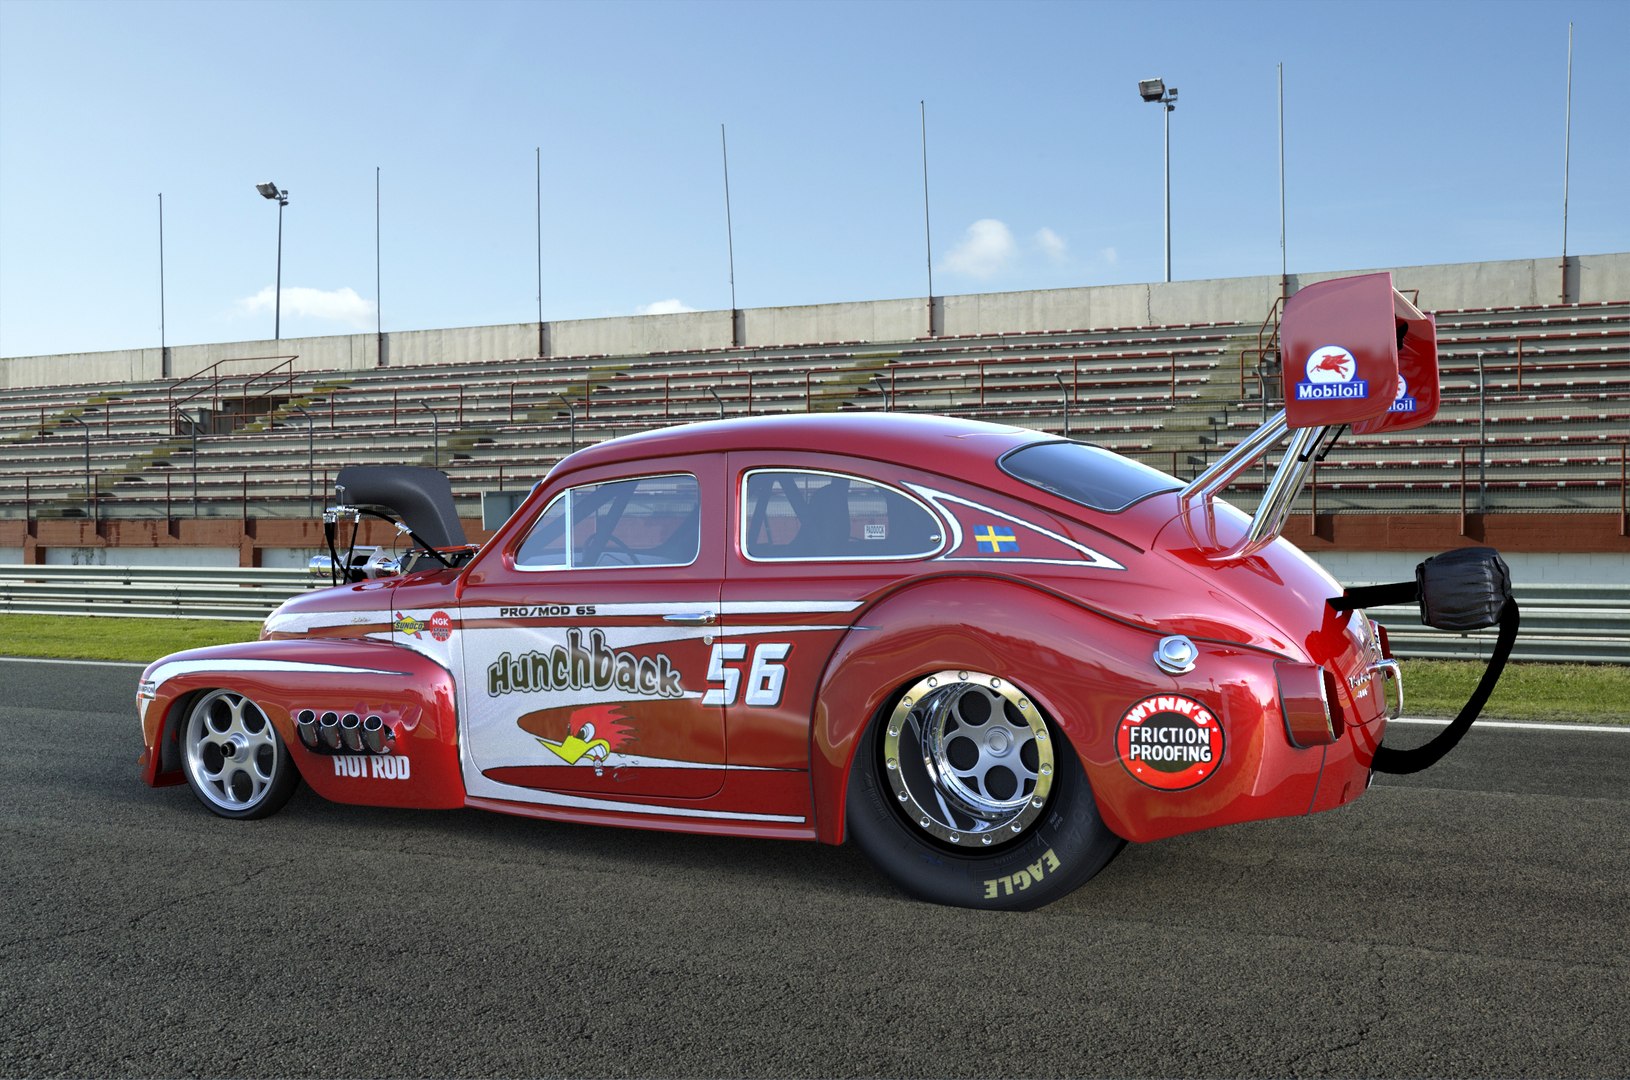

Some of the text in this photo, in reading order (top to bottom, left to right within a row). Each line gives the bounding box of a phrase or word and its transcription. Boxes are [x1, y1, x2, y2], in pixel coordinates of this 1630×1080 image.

[1299, 383, 1364, 398] Mobiloil
[1389, 400, 1412, 410] loil
[500, 606, 596, 617] PRO/MOD 65
[394, 621, 424, 630] SUNOCO
[432, 618, 449, 626] NGK
[488, 628, 684, 697] Hunchback
[702, 643, 793, 706] 56
[1126, 697, 1212, 725] WYNN'S
[1130, 726, 1210, 744] FRICTION
[1130, 744, 1212, 762] PROOFING
[332, 755, 411, 780] HOT ROD
[983, 848, 1061, 899] EAGLE
